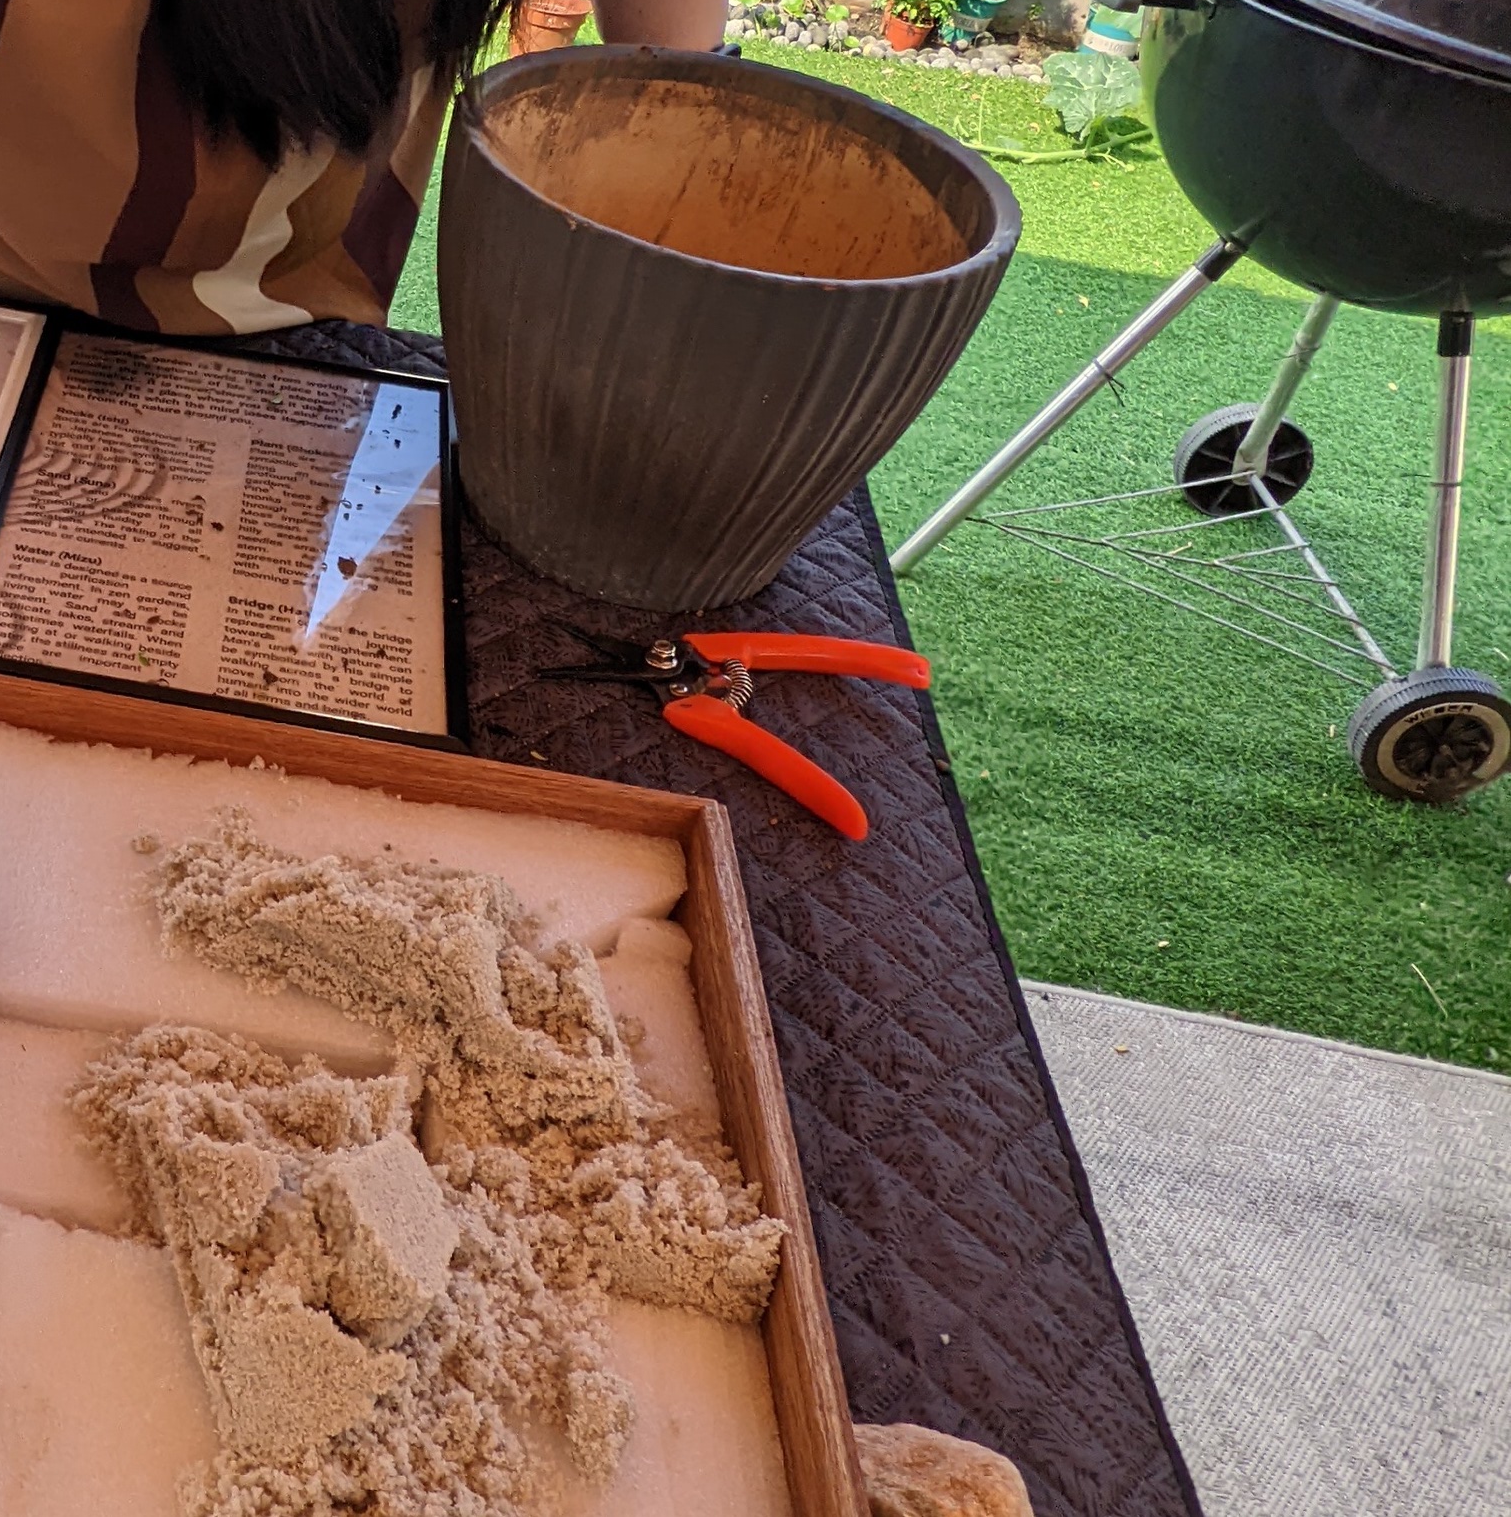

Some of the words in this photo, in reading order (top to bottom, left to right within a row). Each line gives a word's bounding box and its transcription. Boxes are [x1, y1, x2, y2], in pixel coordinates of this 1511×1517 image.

[57, 407, 94, 419] Rocks
[38, 469, 71, 481] Sand
[15, 544, 56, 557] Water
[58, 551, 102, 566] (Mizu)
[12, 554, 48, 564] Water
[63, 563, 120, 578] designed
[151, 578, 193, 591] source
[3, 580, 36, 594] living
[49, 590, 85, 600] water
[64, 601, 98, 613] Sand
[228, 595, 275, 611] Bridge
[102, 618, 153, 633] streams
[160, 628, 185, 639] and
[243, 609, 265, 619] the
[372, 630, 413, 645] bridge
[84, 635, 132, 651] walking
[139, 644, 181, 658] beside
[146, 635, 183, 649] When
[365, 640, 414, 656] journey
[112, 651, 137, 661] and
[222, 635, 261, 648] Man's
[389, 664, 413, 674] can
[220, 655, 270, 672] walking
[350, 676, 391, 692] bridge
[369, 672, 414, 686] simple
[218, 666, 255, 678] move
[313, 681, 335, 692] the
[349, 689, 386, 702] world
[307, 691, 329, 701] the
[334, 697, 370, 709] wider
[376, 704, 413, 717] world
